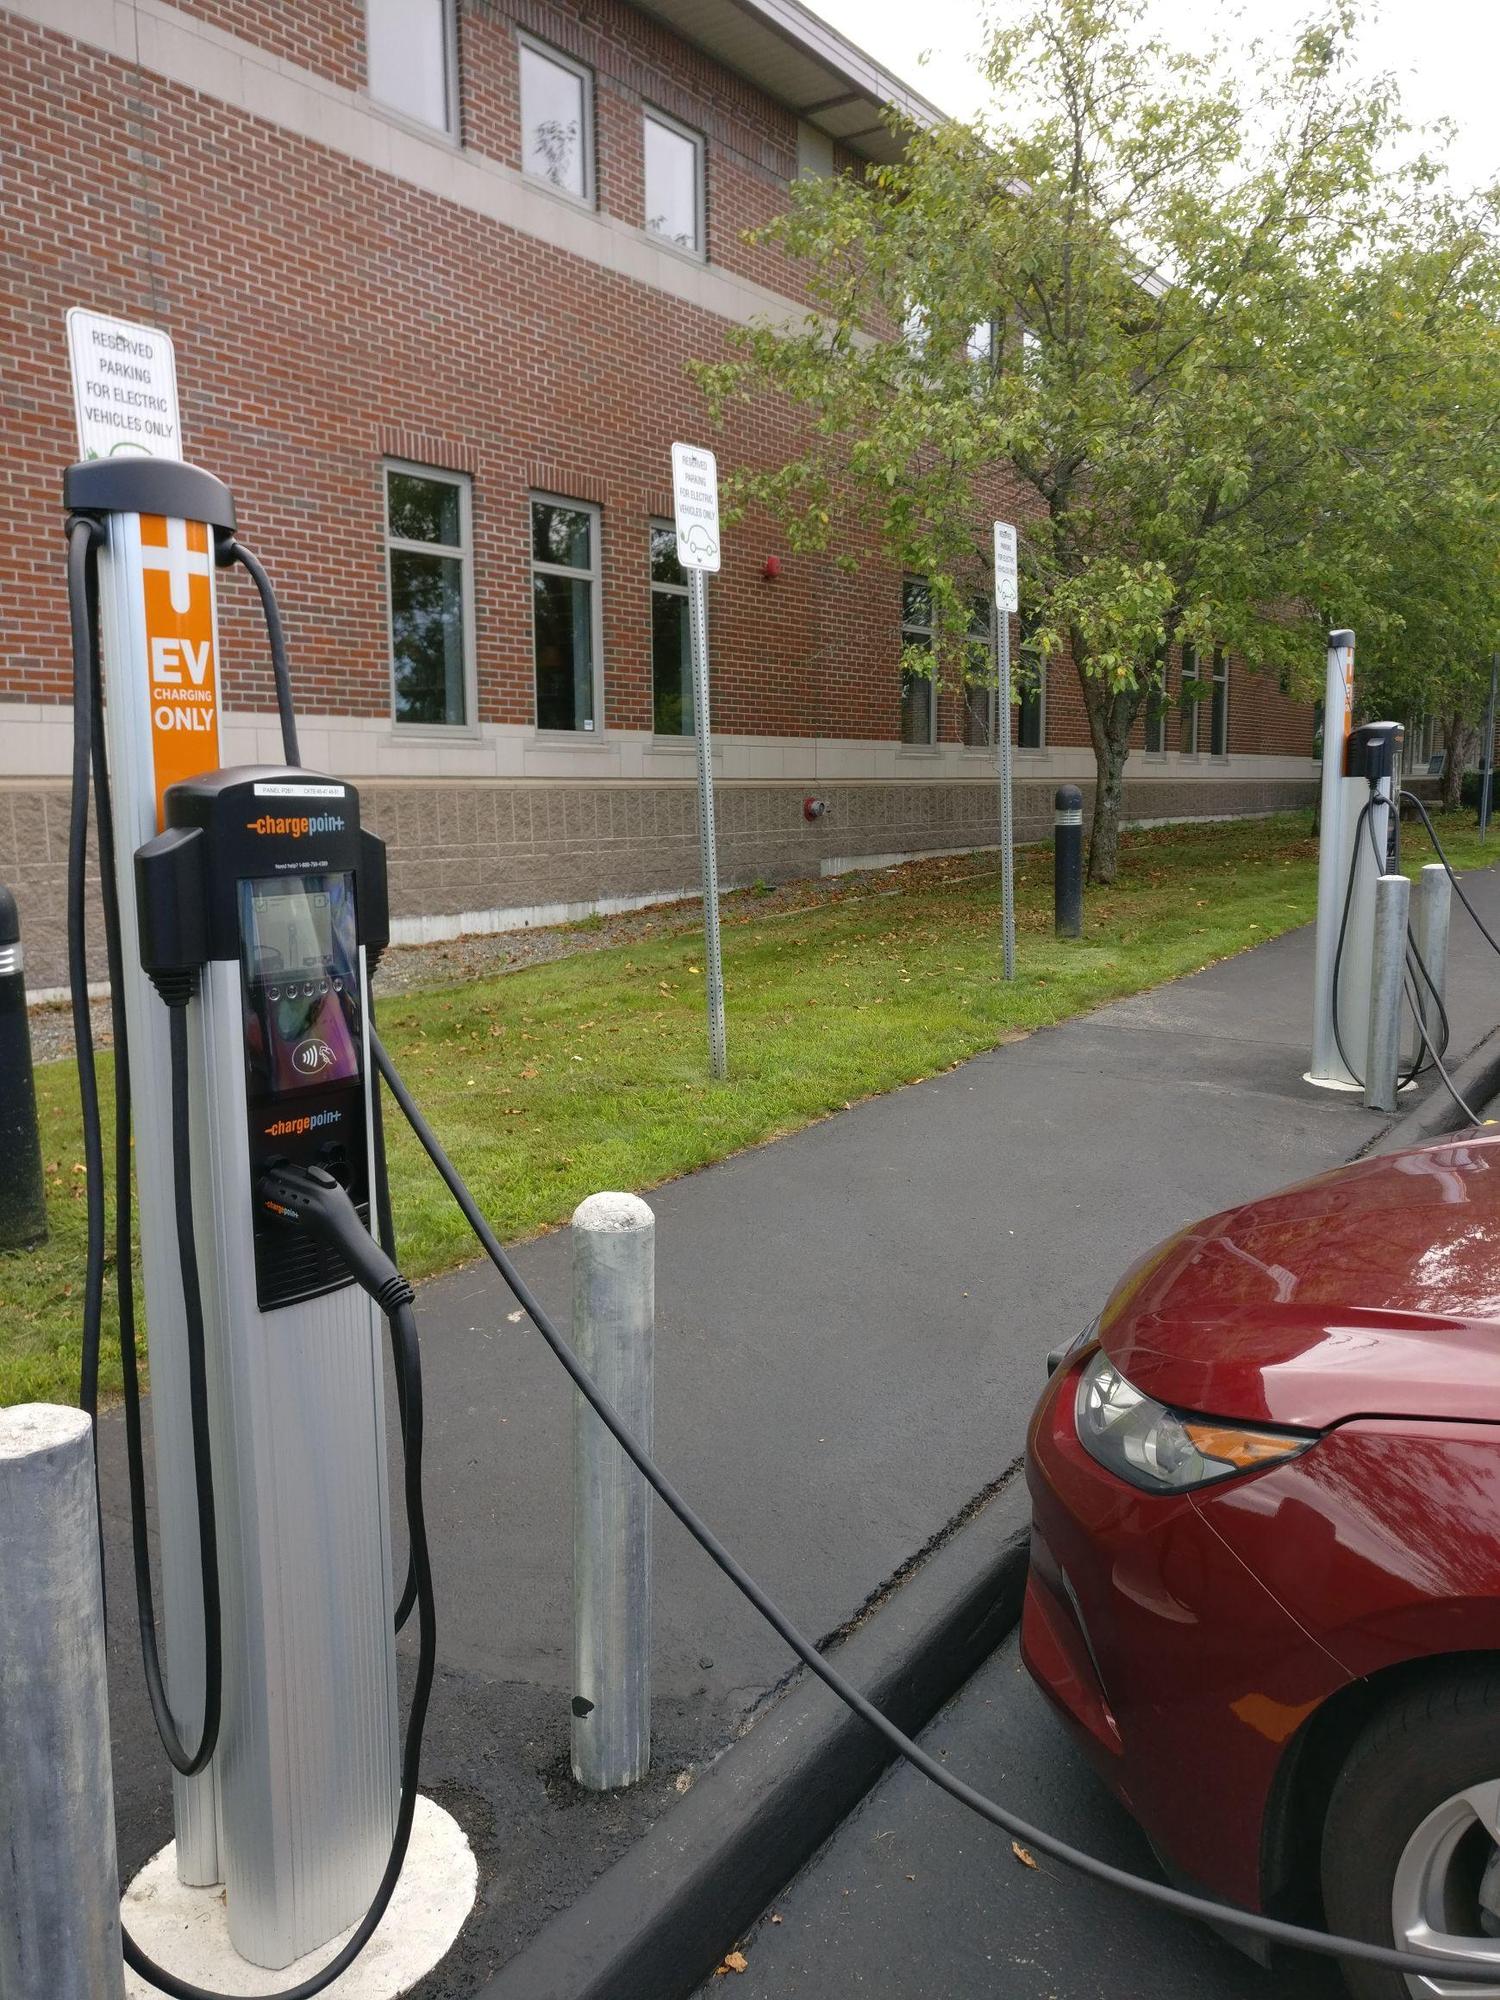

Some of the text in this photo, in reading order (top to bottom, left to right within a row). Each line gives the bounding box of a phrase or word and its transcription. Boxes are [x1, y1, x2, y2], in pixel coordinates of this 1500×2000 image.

[92, 330, 153, 360] RESERVED
[99, 358, 151, 384] PARKING
[86, 381, 167, 413] FOR ELECTRIC
[84, 406, 173, 438] VEHICLES ONLY
[680, 487, 713, 504] FOR ELECTRIC
[679, 503, 702, 518] VEHICLES
[151, 637, 210, 684] EV
[153, 688, 212, 702] CHARGING
[154, 706, 214, 731] ONLY
